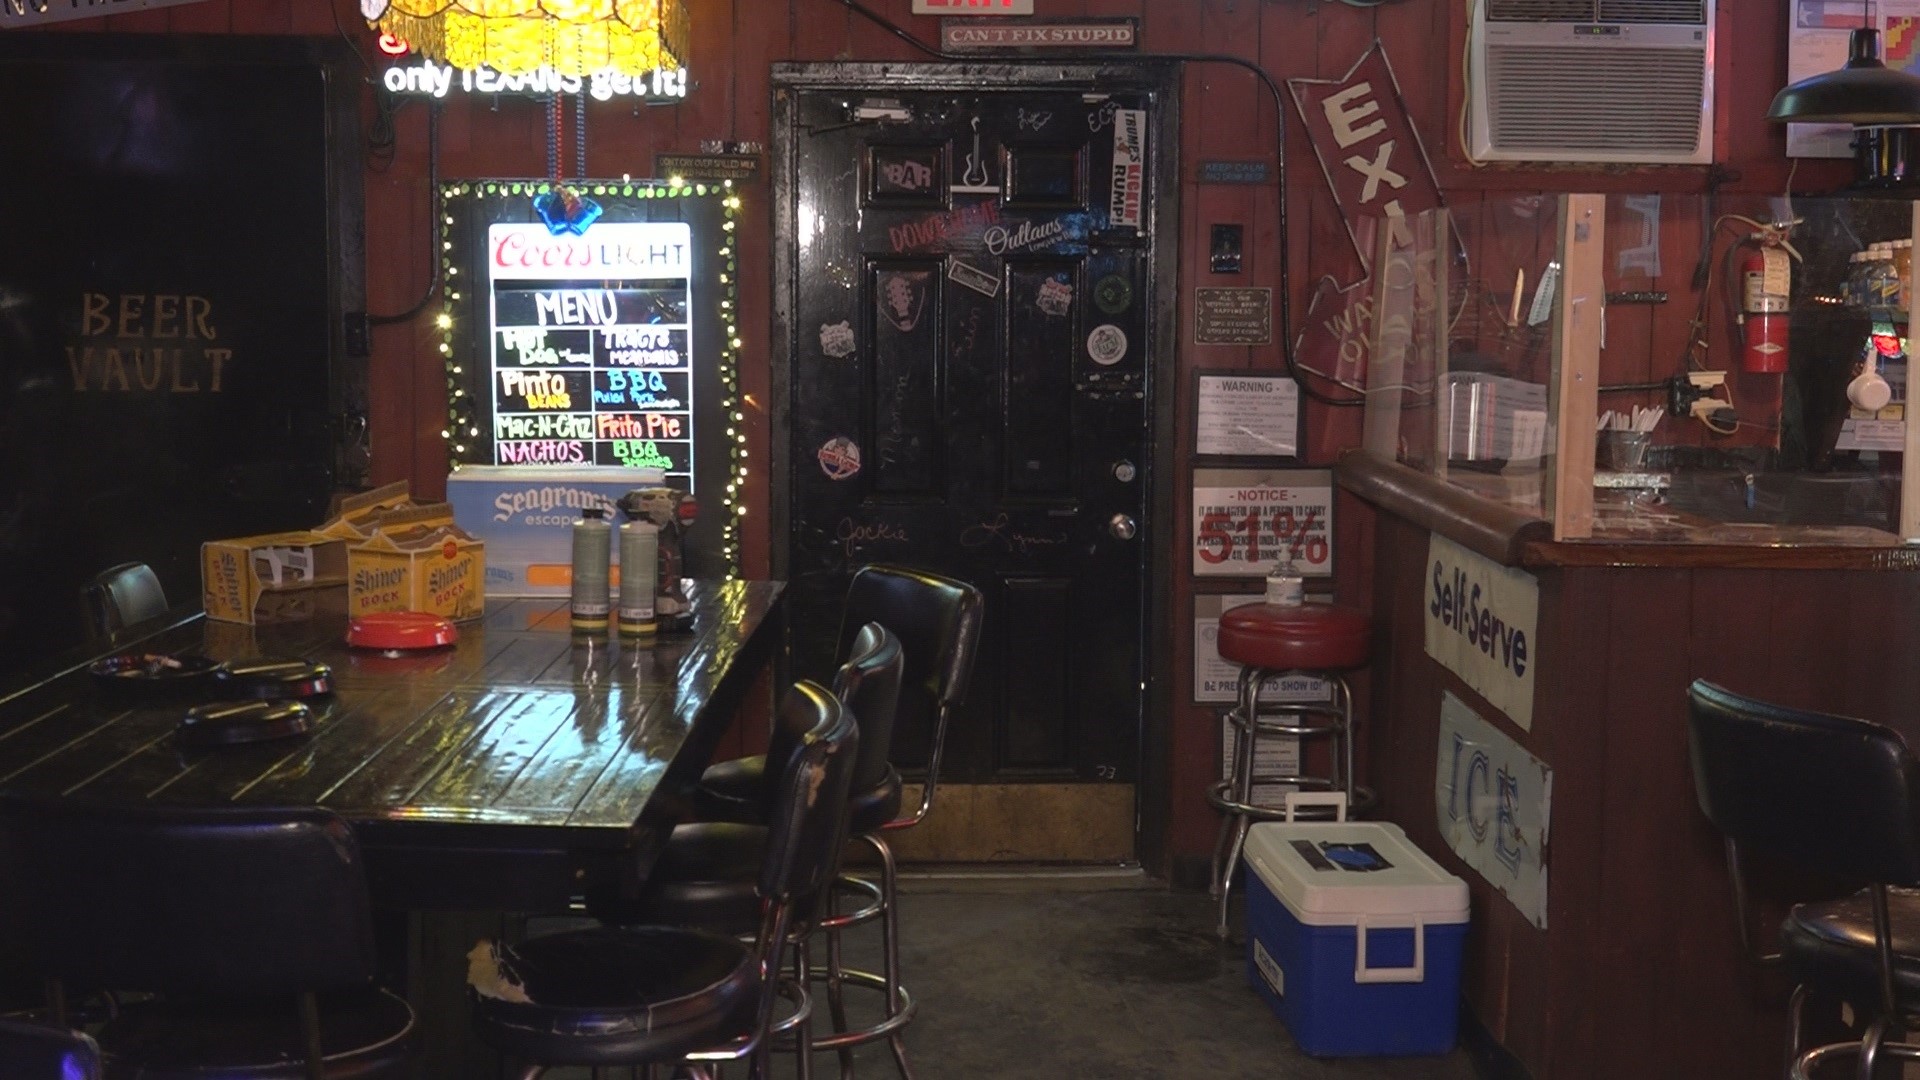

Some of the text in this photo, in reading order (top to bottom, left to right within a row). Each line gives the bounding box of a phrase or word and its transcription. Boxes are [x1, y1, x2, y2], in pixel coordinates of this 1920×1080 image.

[949, 29, 1131, 42] CAN'T FIX STUPID
[384, 58, 452, 98] only
[740, 159, 756, 170] MILK
[887, 161, 931, 190] BAR
[493, 232, 685, 267] Coors LIGHT
[983, 216, 1063, 255] Outlaws
[80, 292, 217, 341] BEER
[535, 290, 618, 326] MENU
[65, 345, 233, 394] VAULT
[525, 392, 572, 409] BEANS
[1221, 380, 1273, 394] WARNING
[499, 440, 585, 464] NACHOS
[612, 440, 660, 458] BBQ
[1237, 489, 1289, 501] NOTICE
[1198, 511, 1328, 565] 51%
[353, 565, 407, 594] Shiner
[428, 556, 473, 595] Shiner
[360, 591, 400, 609] BOCK
[434, 582, 466, 608] BOCK
[1430, 558, 1529, 679] Self-Serve
[1204, 681, 1217, 692] BE
[1267, 681, 1279, 692] TO
[1282, 681, 1308, 692] SHOW
[1448, 731, 1523, 880] ICE
